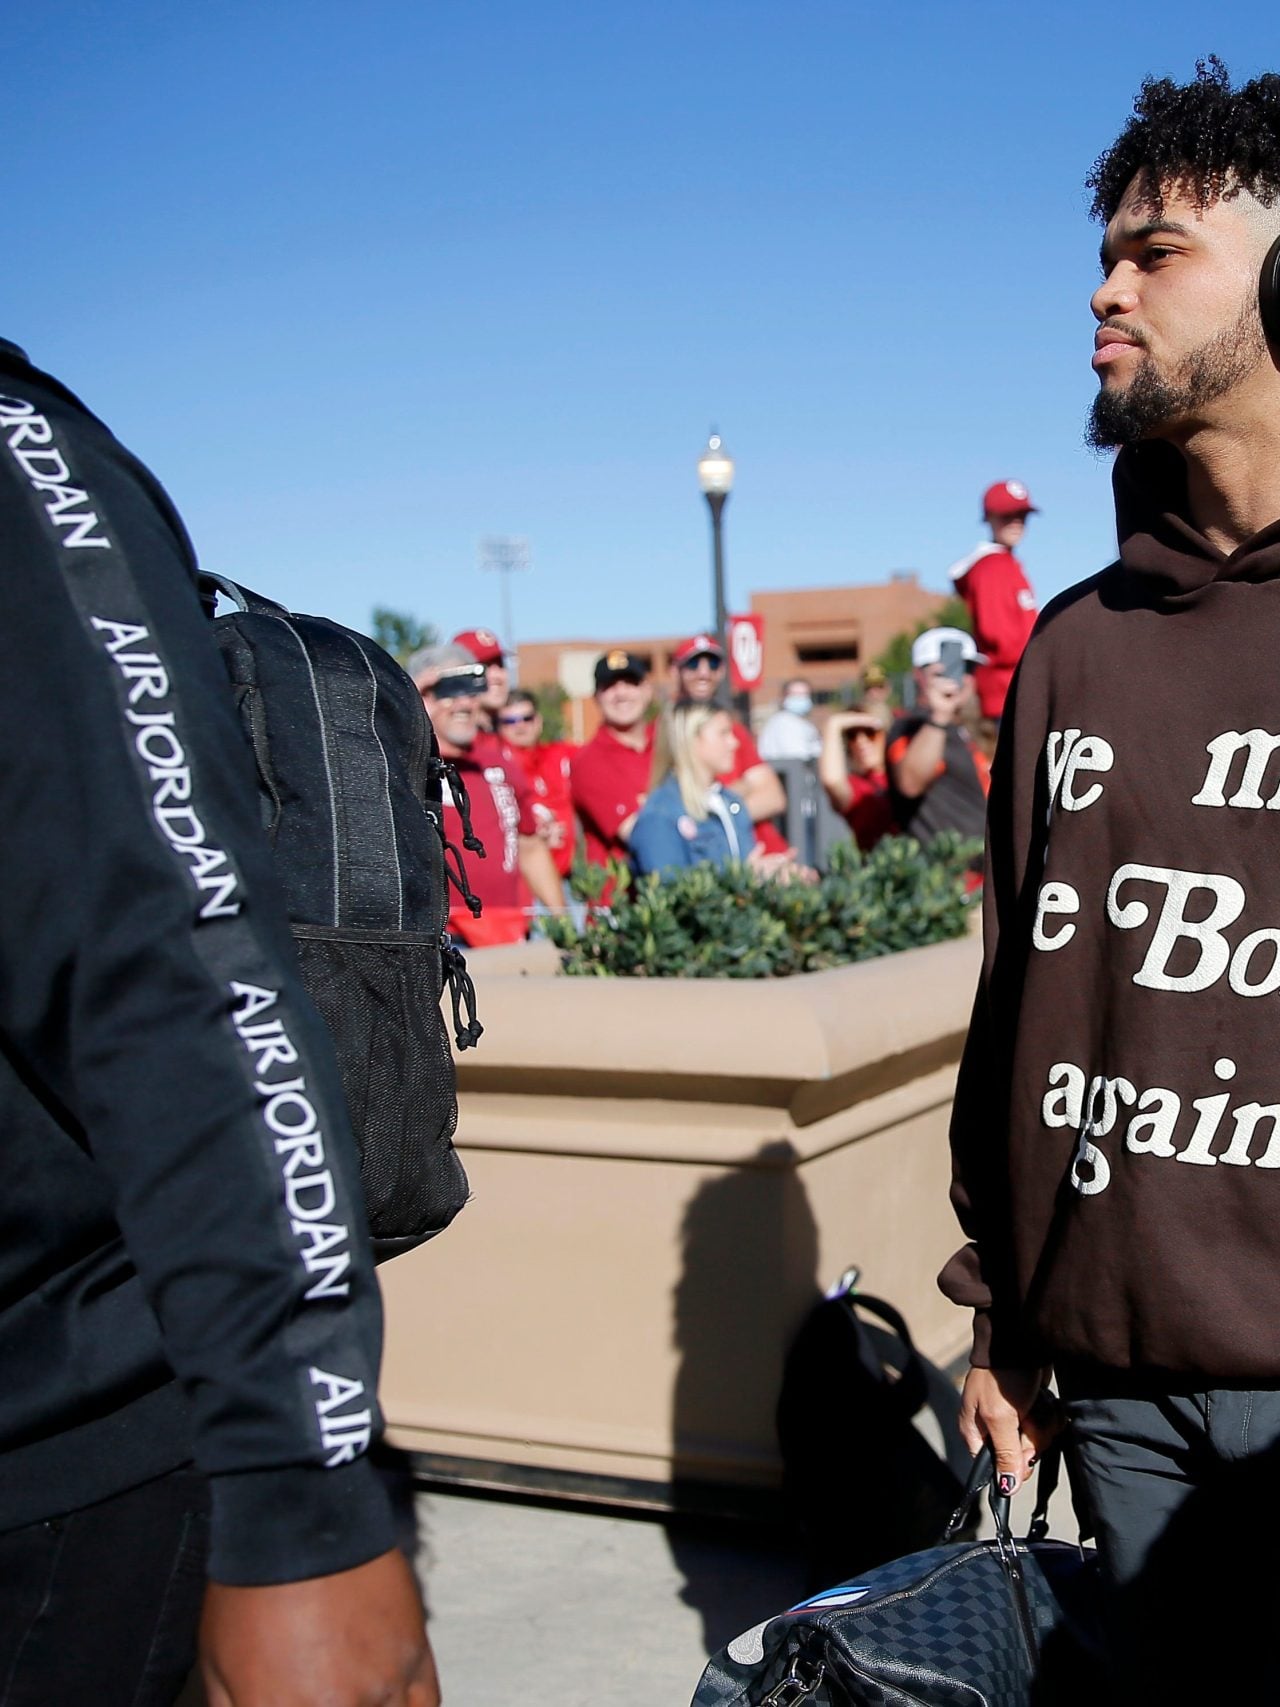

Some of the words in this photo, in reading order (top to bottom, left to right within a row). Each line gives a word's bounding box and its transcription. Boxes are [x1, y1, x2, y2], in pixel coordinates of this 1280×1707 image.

[0, 393, 112, 548] ORDAN
[91, 615, 168, 704] AIR
[126, 707, 243, 919] JORDAN
[1032, 881, 1080, 951] e
[230, 979, 298, 1076] AIR
[254, 1076, 350, 1302] JORDAN
[309, 1366, 371, 1467] AIR
